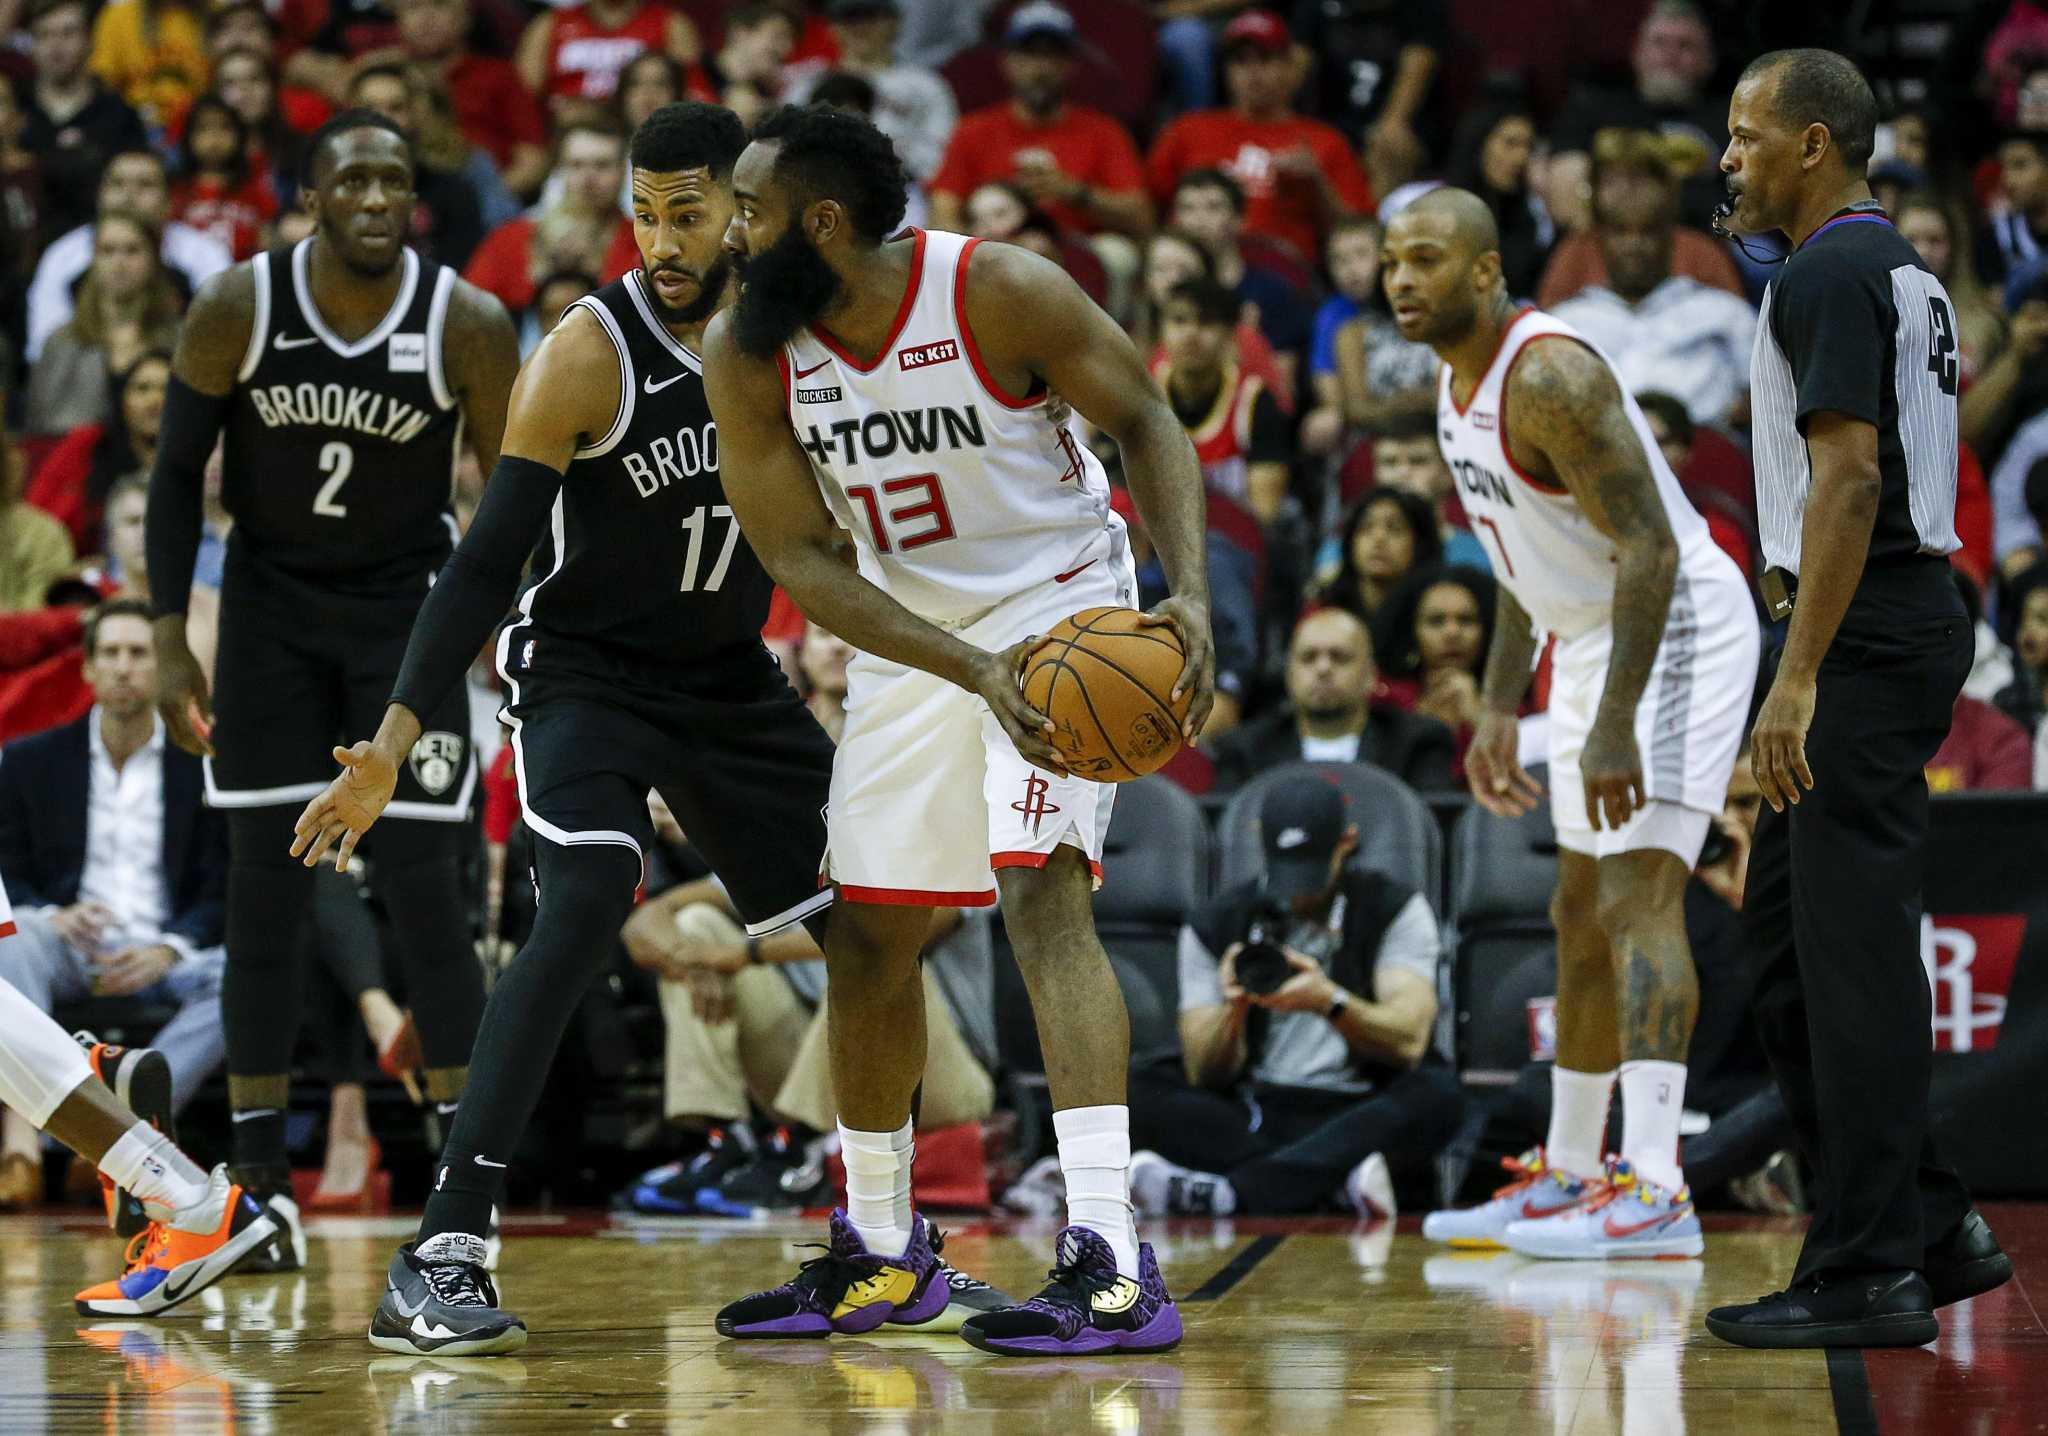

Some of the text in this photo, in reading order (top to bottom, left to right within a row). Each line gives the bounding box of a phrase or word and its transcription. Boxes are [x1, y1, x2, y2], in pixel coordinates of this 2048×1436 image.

[250, 382, 432, 444] BROOKLYN
[798, 387, 839, 404] ROCKETS
[312, 441, 354, 518] 2
[622, 421, 720, 498] BROO
[680, 505, 742, 592] 17
[845, 472, 958, 555] 13
